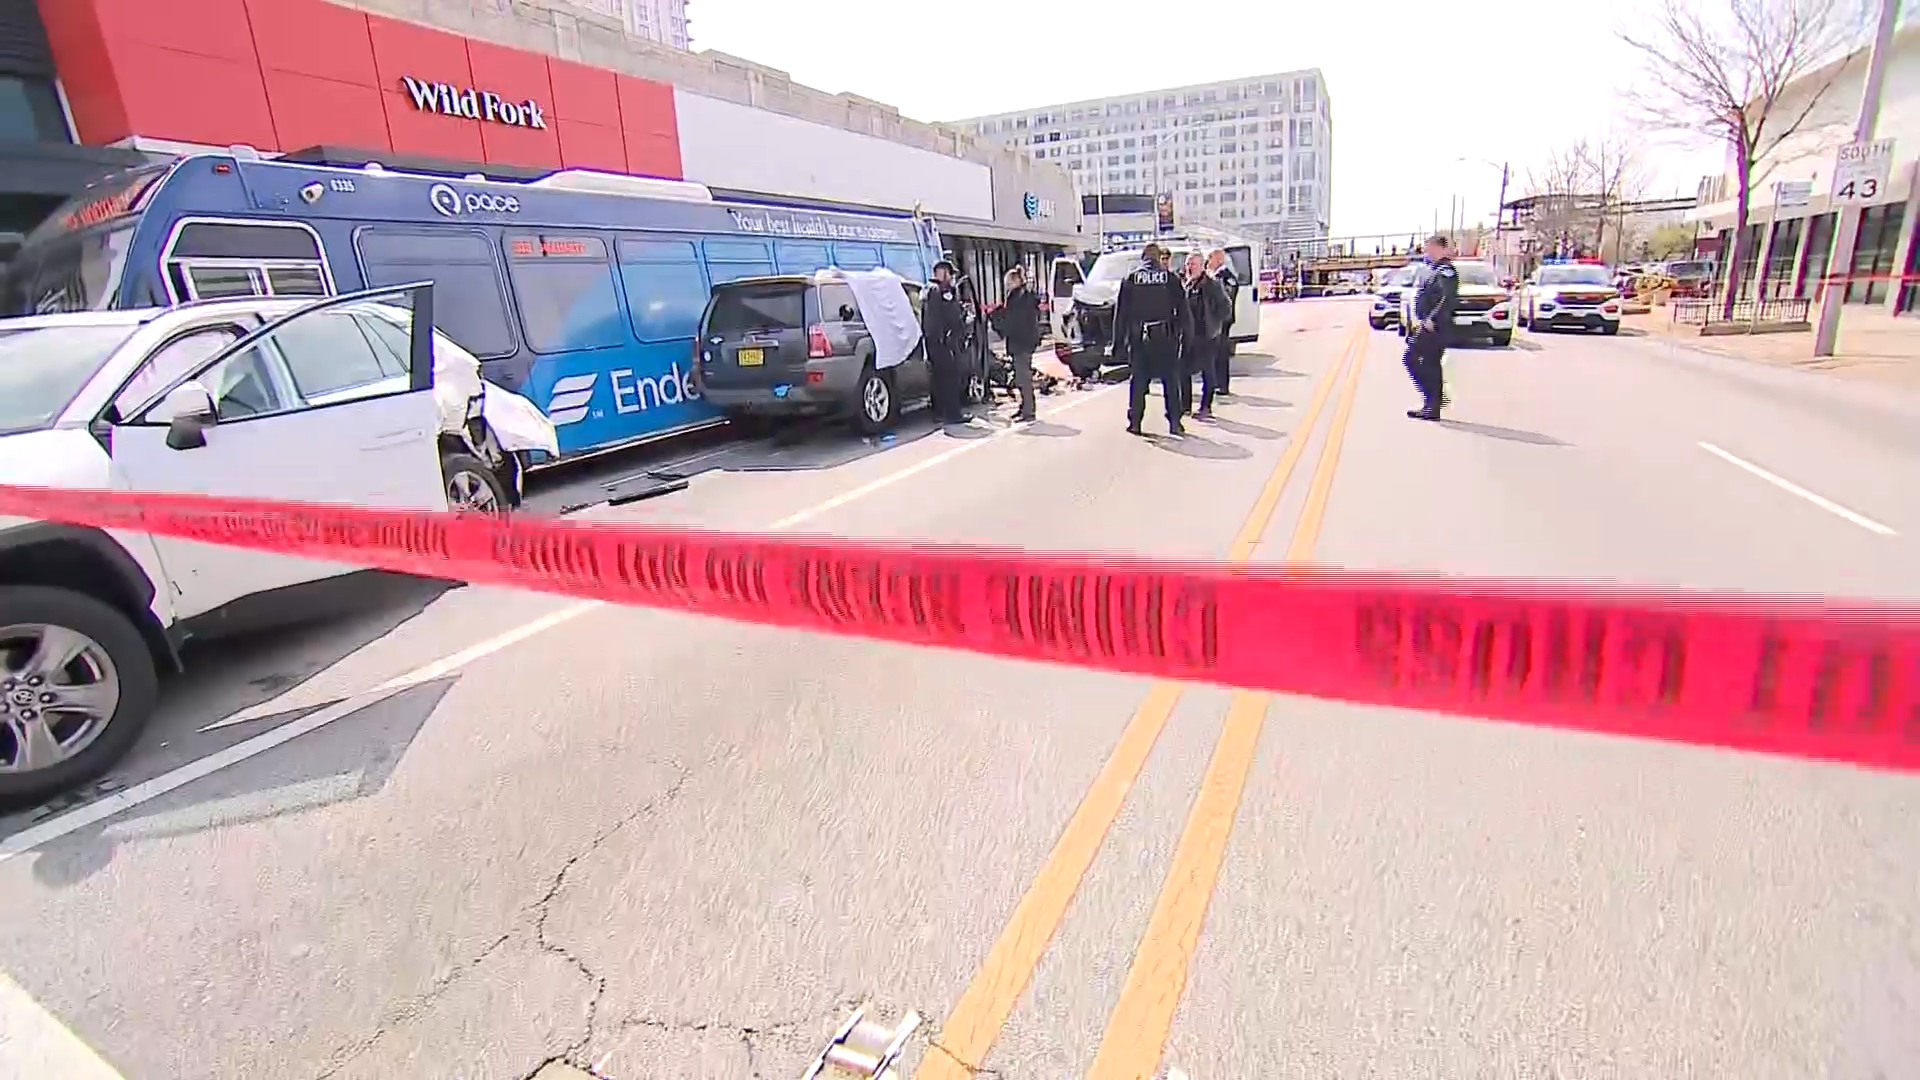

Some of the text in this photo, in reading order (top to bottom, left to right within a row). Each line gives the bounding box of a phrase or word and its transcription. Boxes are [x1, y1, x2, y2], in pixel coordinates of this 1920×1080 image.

[400, 76, 548, 130] Wild Fork
[1840, 143, 1892, 161] SOUTH
[1838, 178, 1878, 200] 43
[465, 193, 520, 213] pace
[730, 211, 764, 232] Your
[1136, 271, 1168, 285] POLICE
[609, 360, 700, 414] Ende
